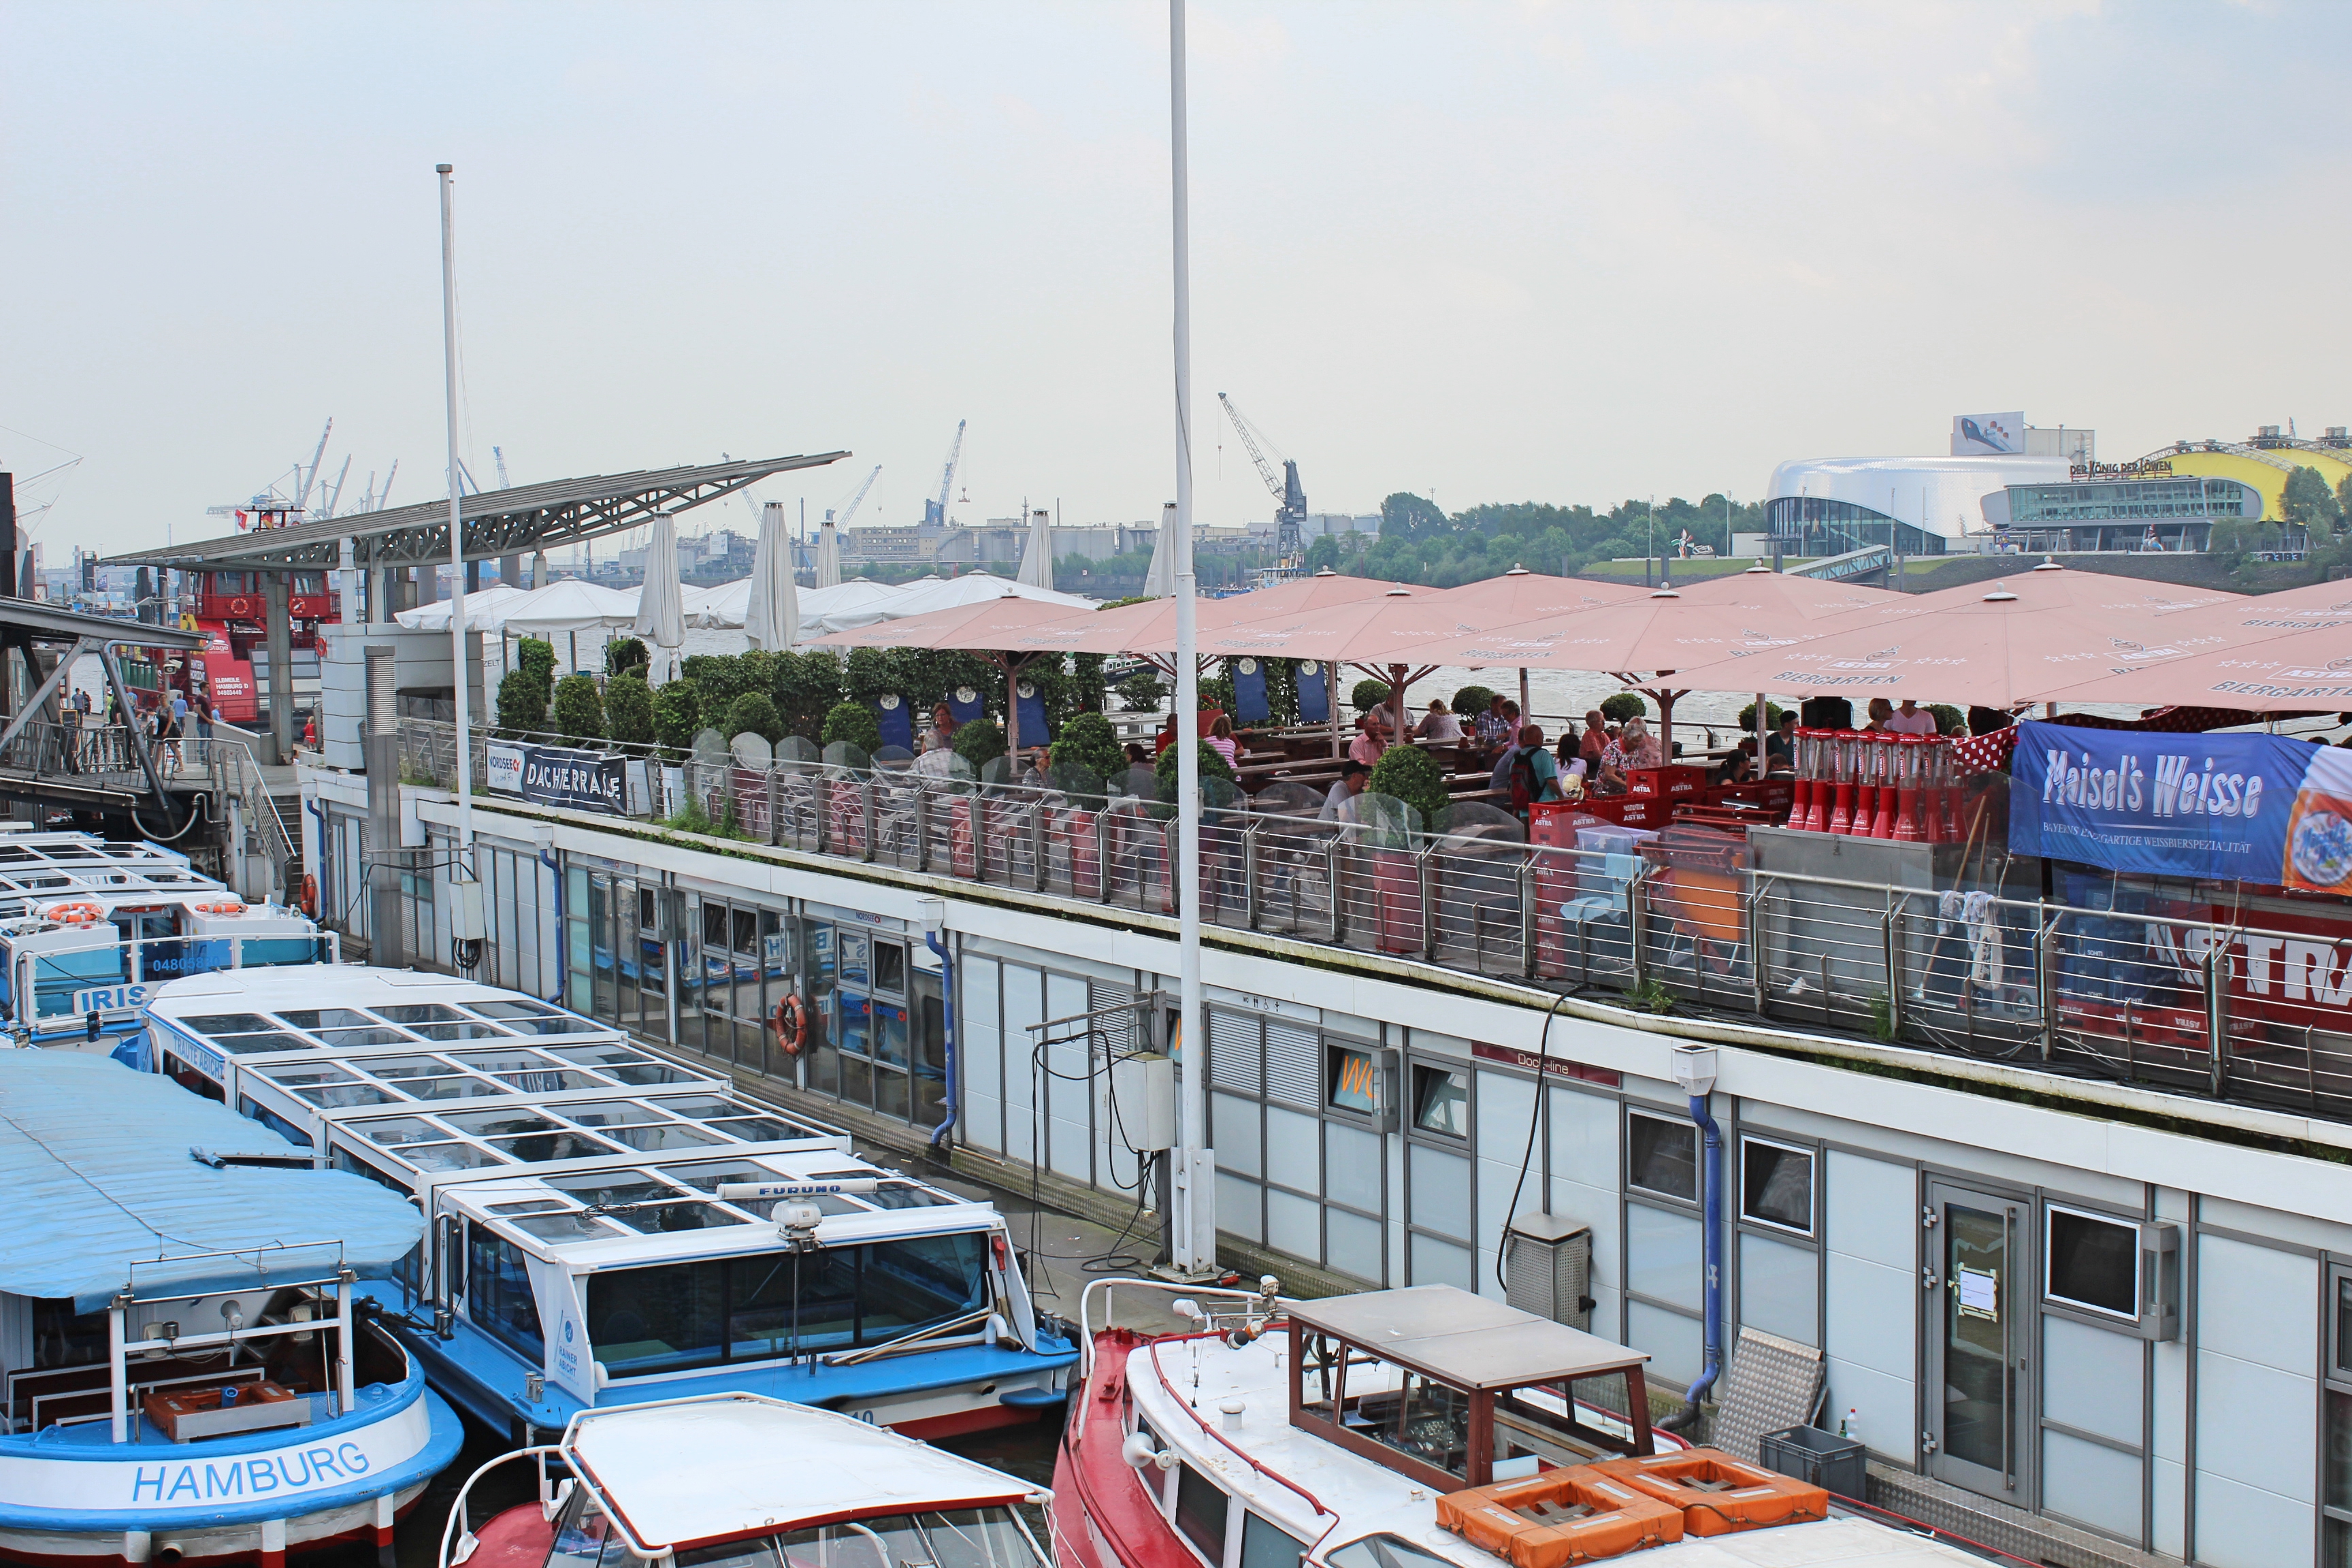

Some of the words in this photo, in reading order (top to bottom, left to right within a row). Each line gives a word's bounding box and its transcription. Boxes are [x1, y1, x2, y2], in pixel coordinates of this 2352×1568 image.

[2070, 466, 2087, 475] DER
[2089, 461, 2119, 478] KÖNIG
[2121, 463, 2138, 473] DER
[2140, 458, 2172, 476] LÖWEN
[1457, 649, 1558, 659] BIERGARTEN
[2120, 648, 2182, 660] ASTRA
[1829, 660, 1893, 669] ASTRA
[1770, 670, 1906, 686] BIERGARTEN
[2281, 670, 2352, 678] ASTR
[489, 755, 512, 770] NORDSEE
[1633, 785, 1651, 794] ASTRA
[1671, 784, 1693, 792] ASTRA
[2042, 749, 2143, 811] Maisel's
[2153, 755, 2263, 818] Weisse
[1624, 814, 1646, 822] ASTRA
[2043, 821, 2079, 836] BAYERNS
[855, 911, 875, 923] NORDSEE
[81, 985, 148, 1013] IRIS
[841, 998, 862, 1011] NORDSEE
[875, 1005, 898, 1017] NORDSEE
[174, 1034, 198, 1065] TRAUTE
[199, 1051, 225, 1081] ABICHT
[759, 1185, 841, 1195] FURUNO
[559, 1345, 578, 1366] RAINER
[559, 1358, 576, 1377] ABICHT
[133, 1441, 371, 1501] HAMBURG
